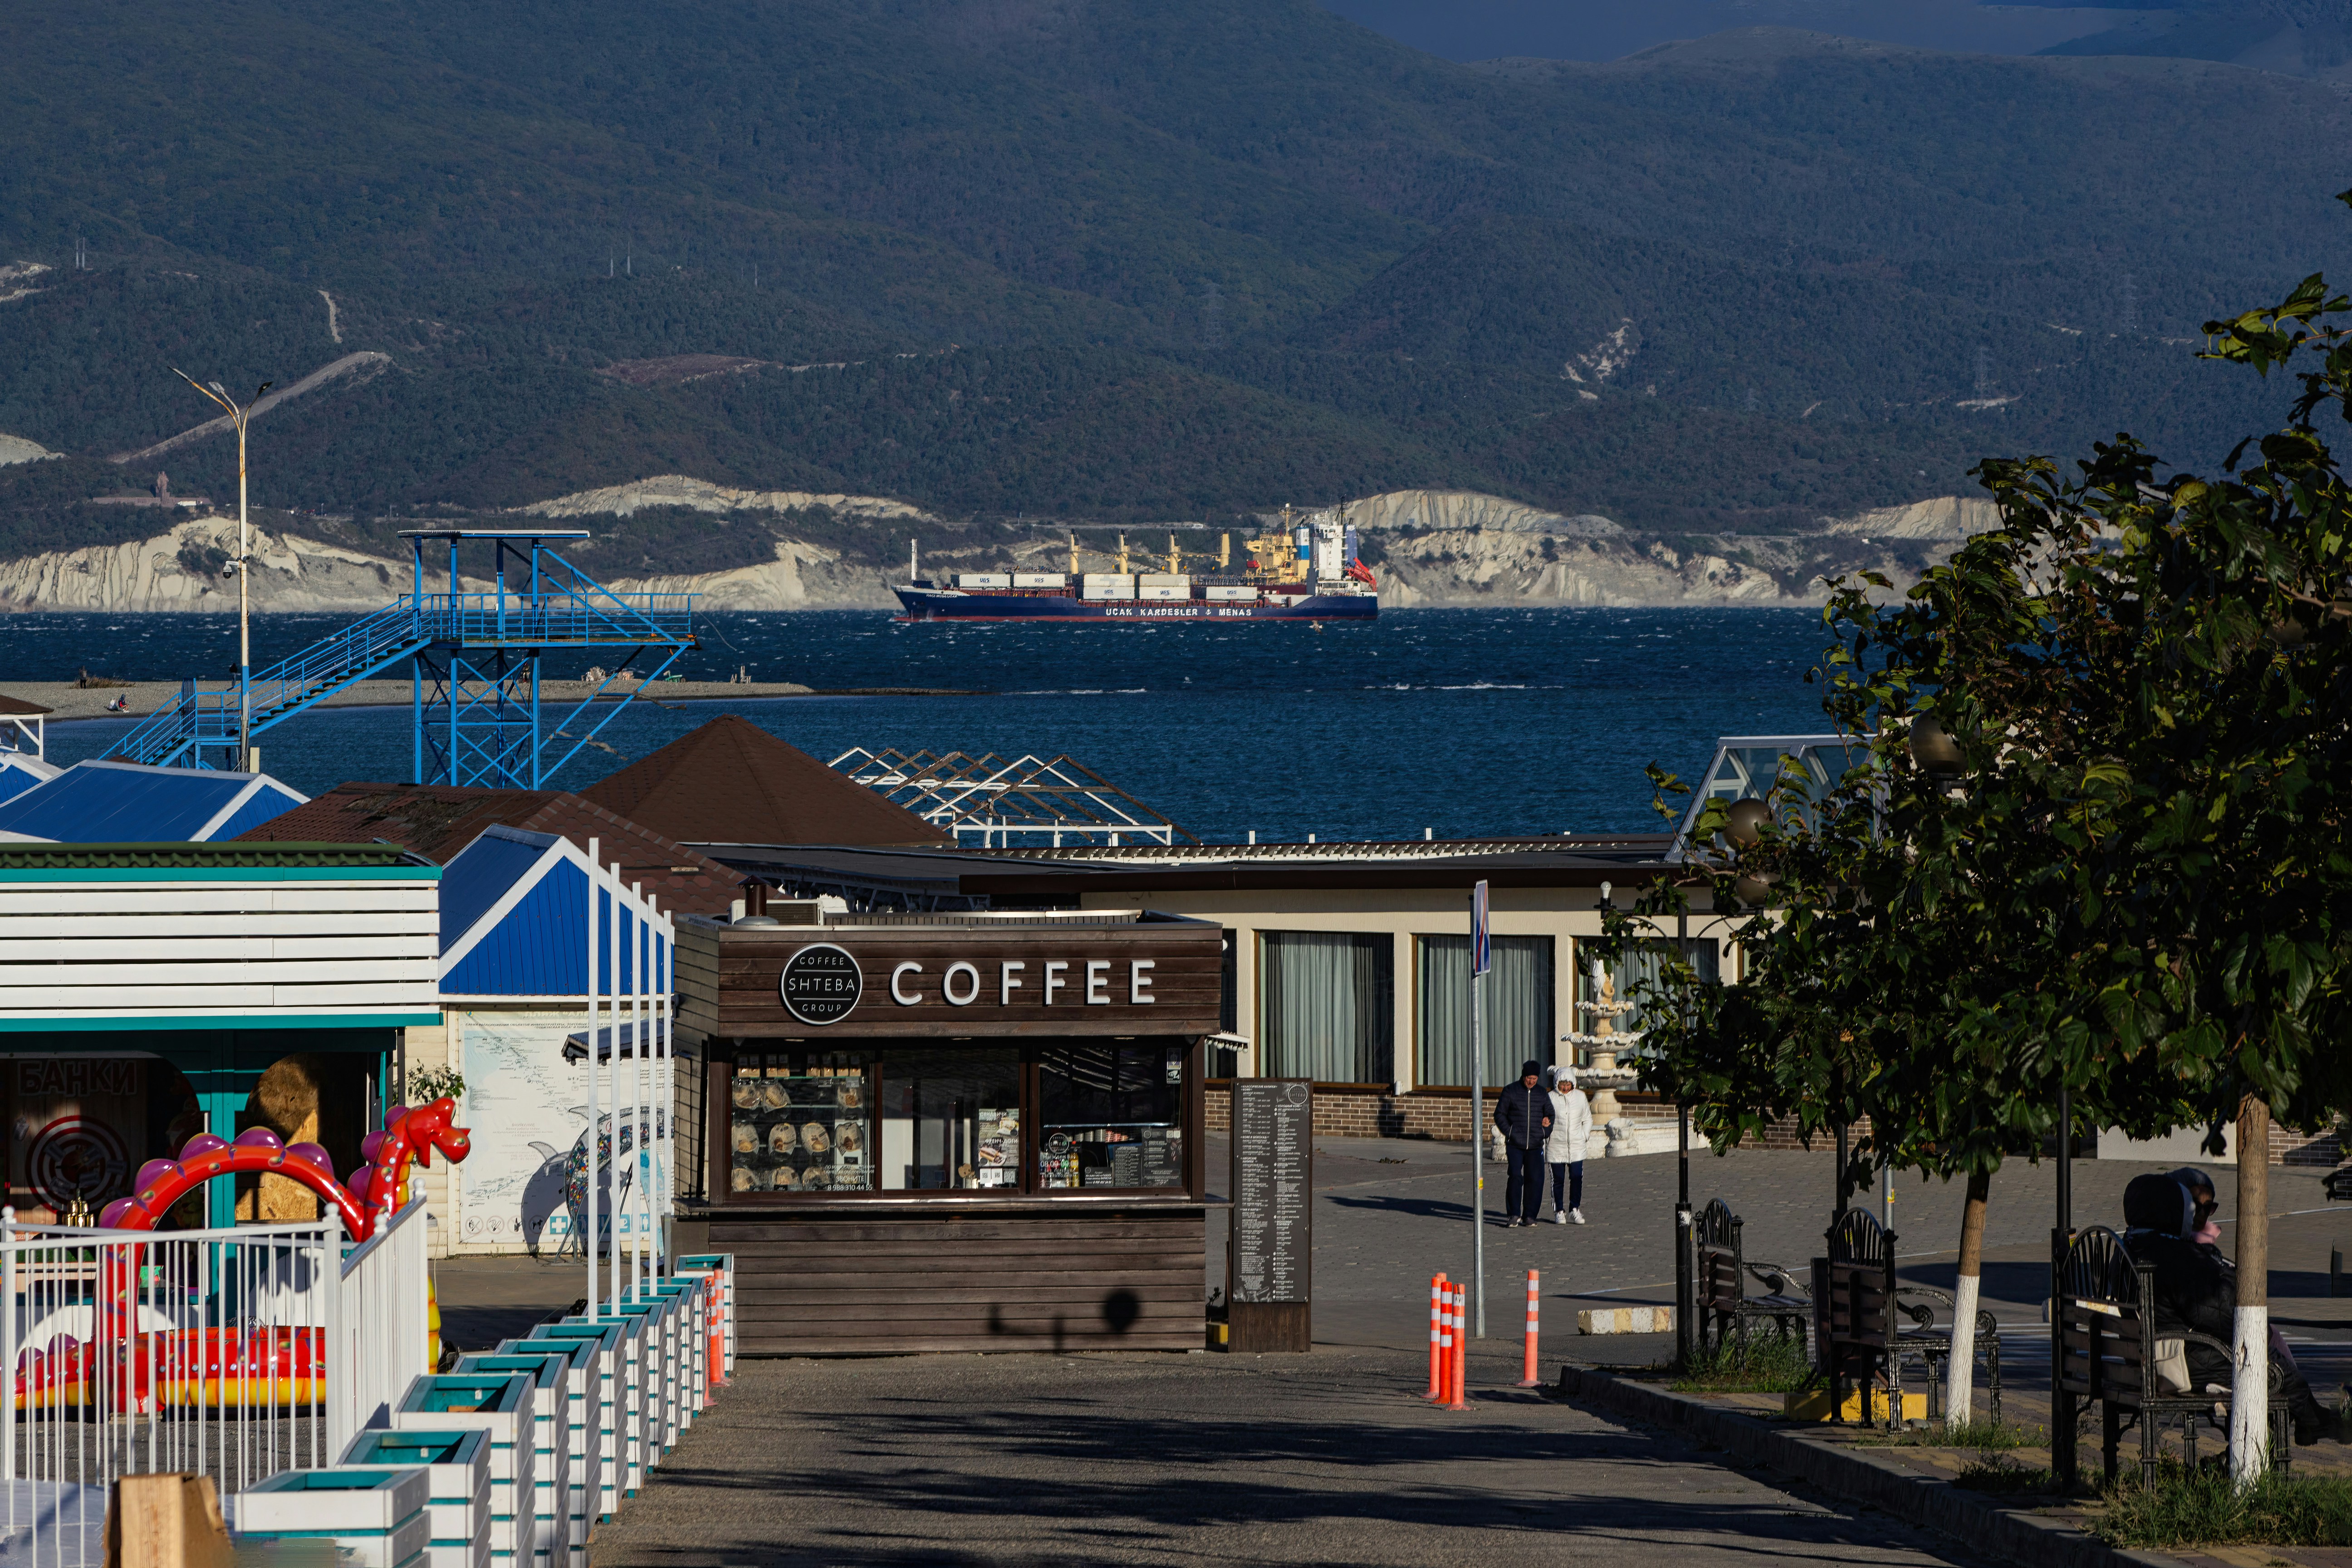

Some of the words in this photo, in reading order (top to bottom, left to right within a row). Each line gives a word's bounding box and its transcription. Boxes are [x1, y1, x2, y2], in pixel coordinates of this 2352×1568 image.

[799, 956, 845, 966] COFFEE
[789, 978, 856, 992] SHTEBA
[890, 960, 1156, 1006] COFFEE
[801, 1003, 842, 1012] GROUP
[18, 1058, 137, 1097] БАНКИ
